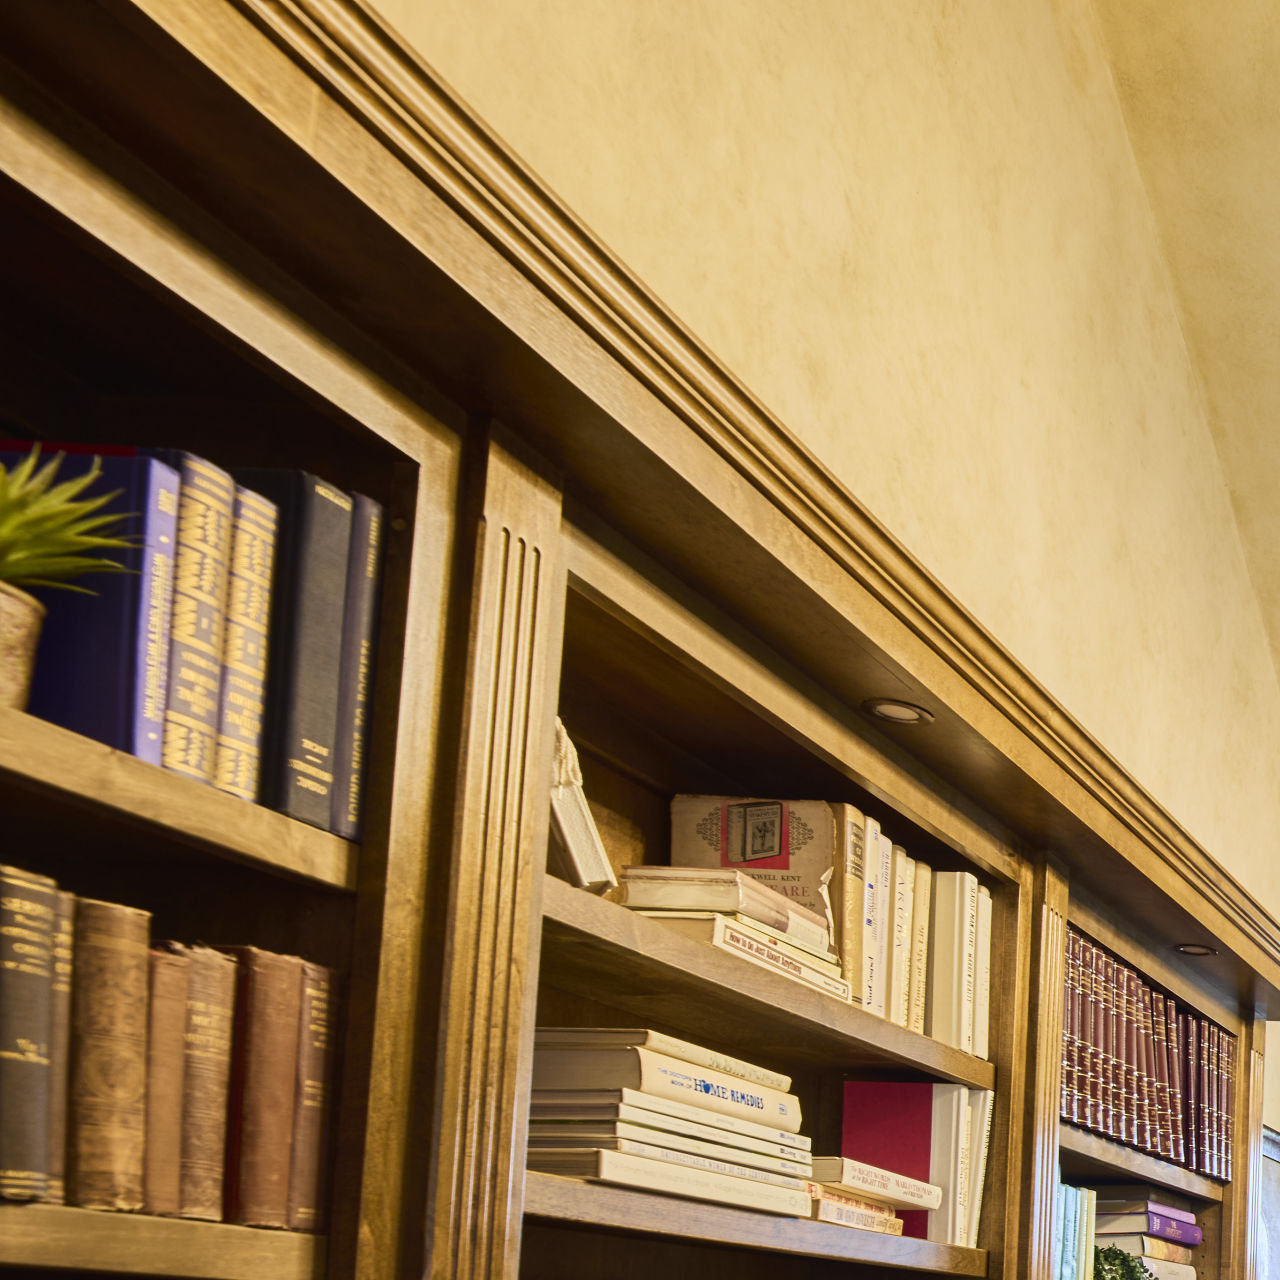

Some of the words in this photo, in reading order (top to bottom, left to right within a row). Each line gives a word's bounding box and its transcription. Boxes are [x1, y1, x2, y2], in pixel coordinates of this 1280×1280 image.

[357, 639, 371, 702] ROCKETS
[781, 874, 801, 882] KENT
[766, 948, 781, 964] About
[782, 955, 802, 976] Anything
[913, 980, 922, 1010] Times
[731, 1090, 765, 1110] REMEDIES
